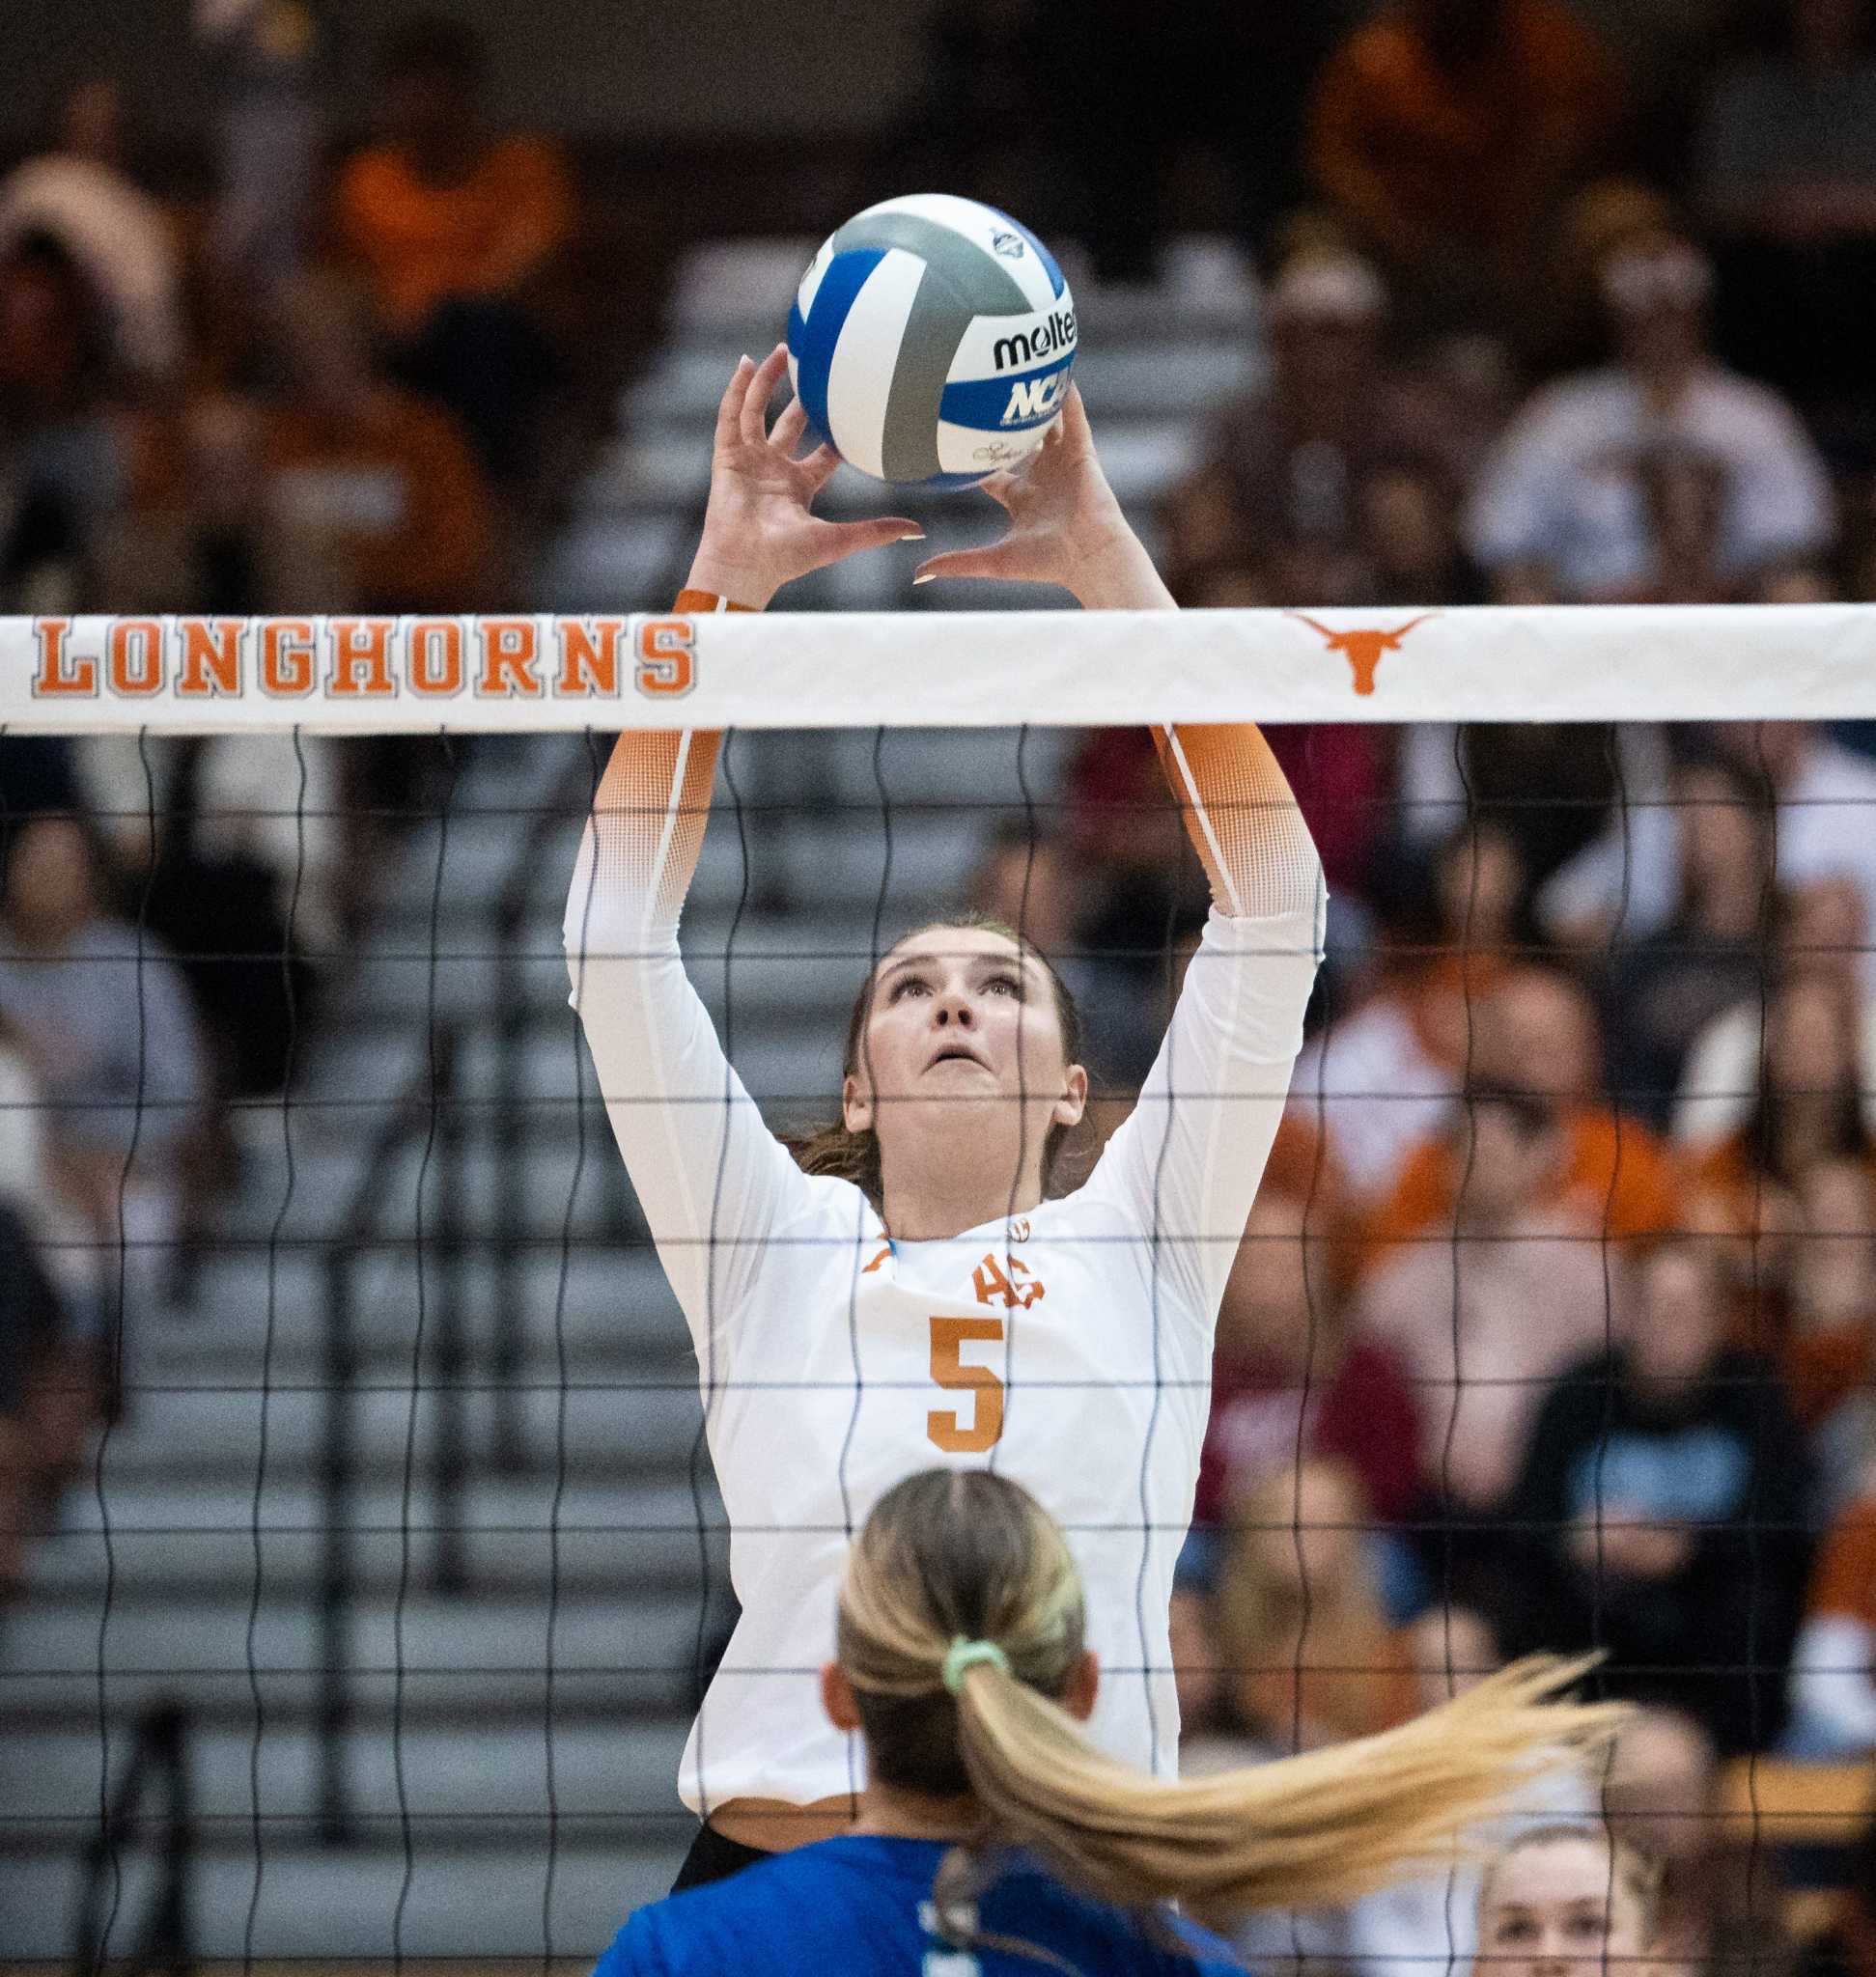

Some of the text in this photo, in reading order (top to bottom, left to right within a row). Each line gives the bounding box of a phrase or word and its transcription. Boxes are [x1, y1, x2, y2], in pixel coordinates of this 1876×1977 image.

[994, 311, 1077, 371] molte
[31, 615, 697, 700] LONGHORNS
[927, 1317, 1005, 1452] 5
